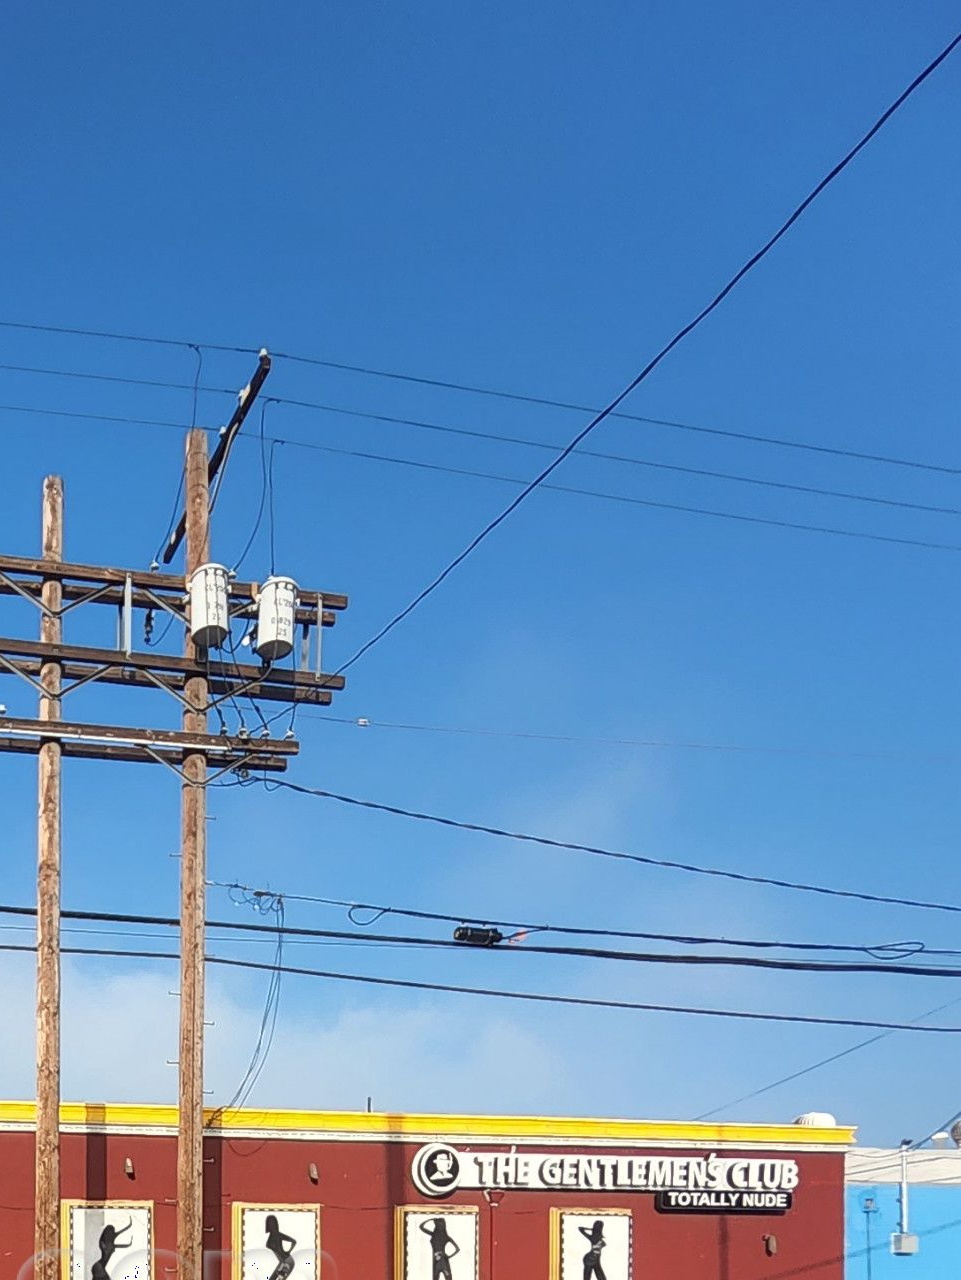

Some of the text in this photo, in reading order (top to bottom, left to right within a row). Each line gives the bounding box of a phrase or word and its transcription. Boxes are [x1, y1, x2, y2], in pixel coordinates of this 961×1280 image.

[473, 1156, 529, 1186] THE
[726, 1161, 799, 1189] CLUB
[668, 1191, 788, 1208] TOTALLY NUDE
